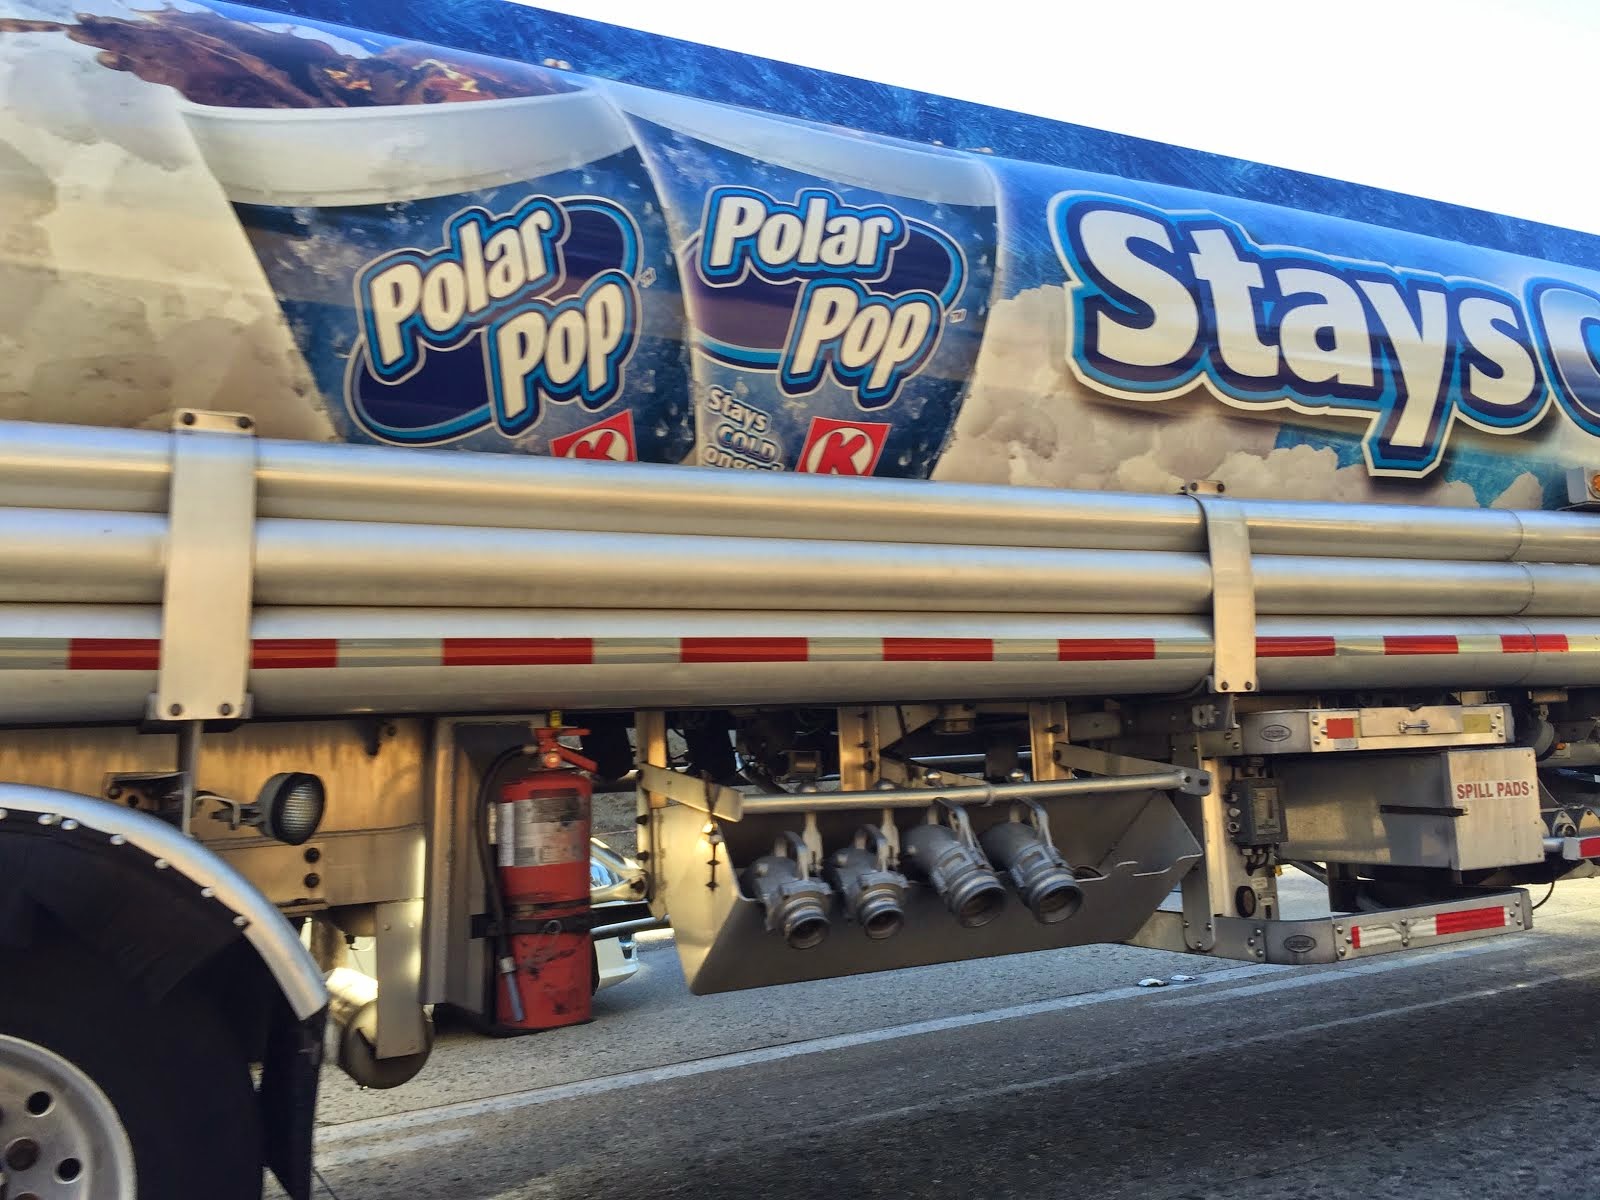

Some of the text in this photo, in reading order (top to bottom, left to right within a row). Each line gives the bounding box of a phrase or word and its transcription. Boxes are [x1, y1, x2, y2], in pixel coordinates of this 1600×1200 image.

[710, 196, 893, 266] Polar
[370, 209, 551, 365] Polar
[1080, 209, 1536, 447] Stays
[496, 283, 626, 419] Pop
[791, 286, 932, 389] Pop
[706, 389, 767, 430] Stays
[718, 425, 776, 461] COLD
[1457, 781, 1529, 799] SPILL PADS
